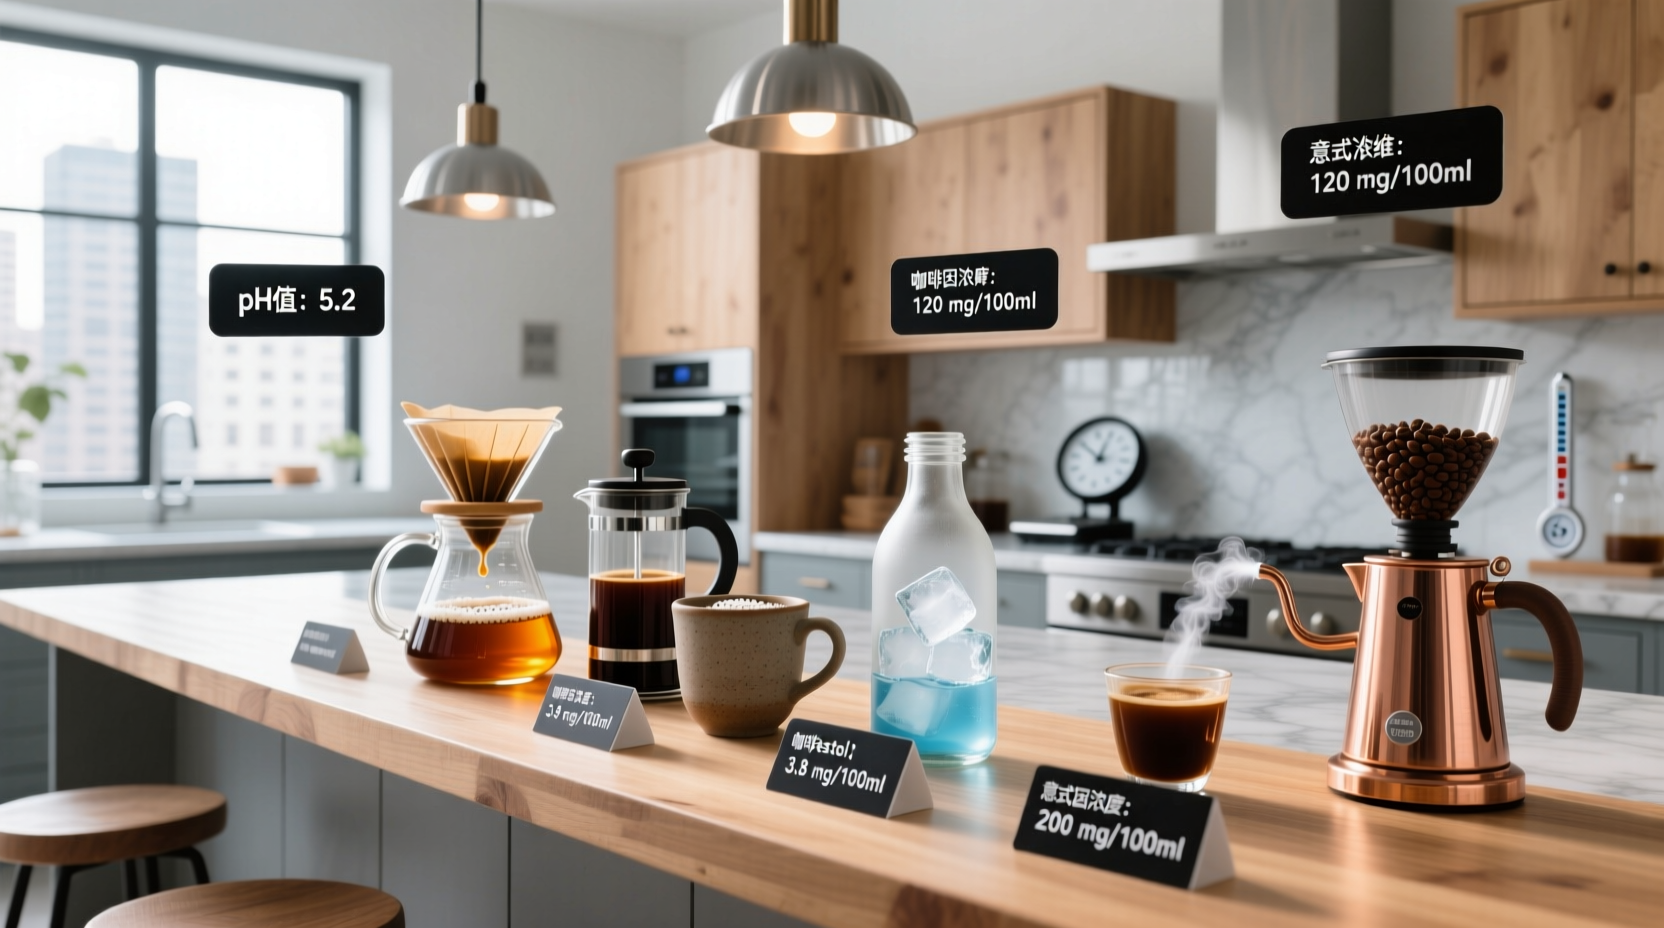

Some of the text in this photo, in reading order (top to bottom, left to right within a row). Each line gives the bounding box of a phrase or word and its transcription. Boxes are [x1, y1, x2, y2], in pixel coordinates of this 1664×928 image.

[1310, 158, 1472, 195] 120 mg/100ml
[319, 287, 356, 312] 5.2
[912, 290, 1037, 318] 120 mg/100ml
[784, 755, 887, 794] 3.8 mg/100ml
[1034, 808, 1187, 862] 200 mg/100ml
